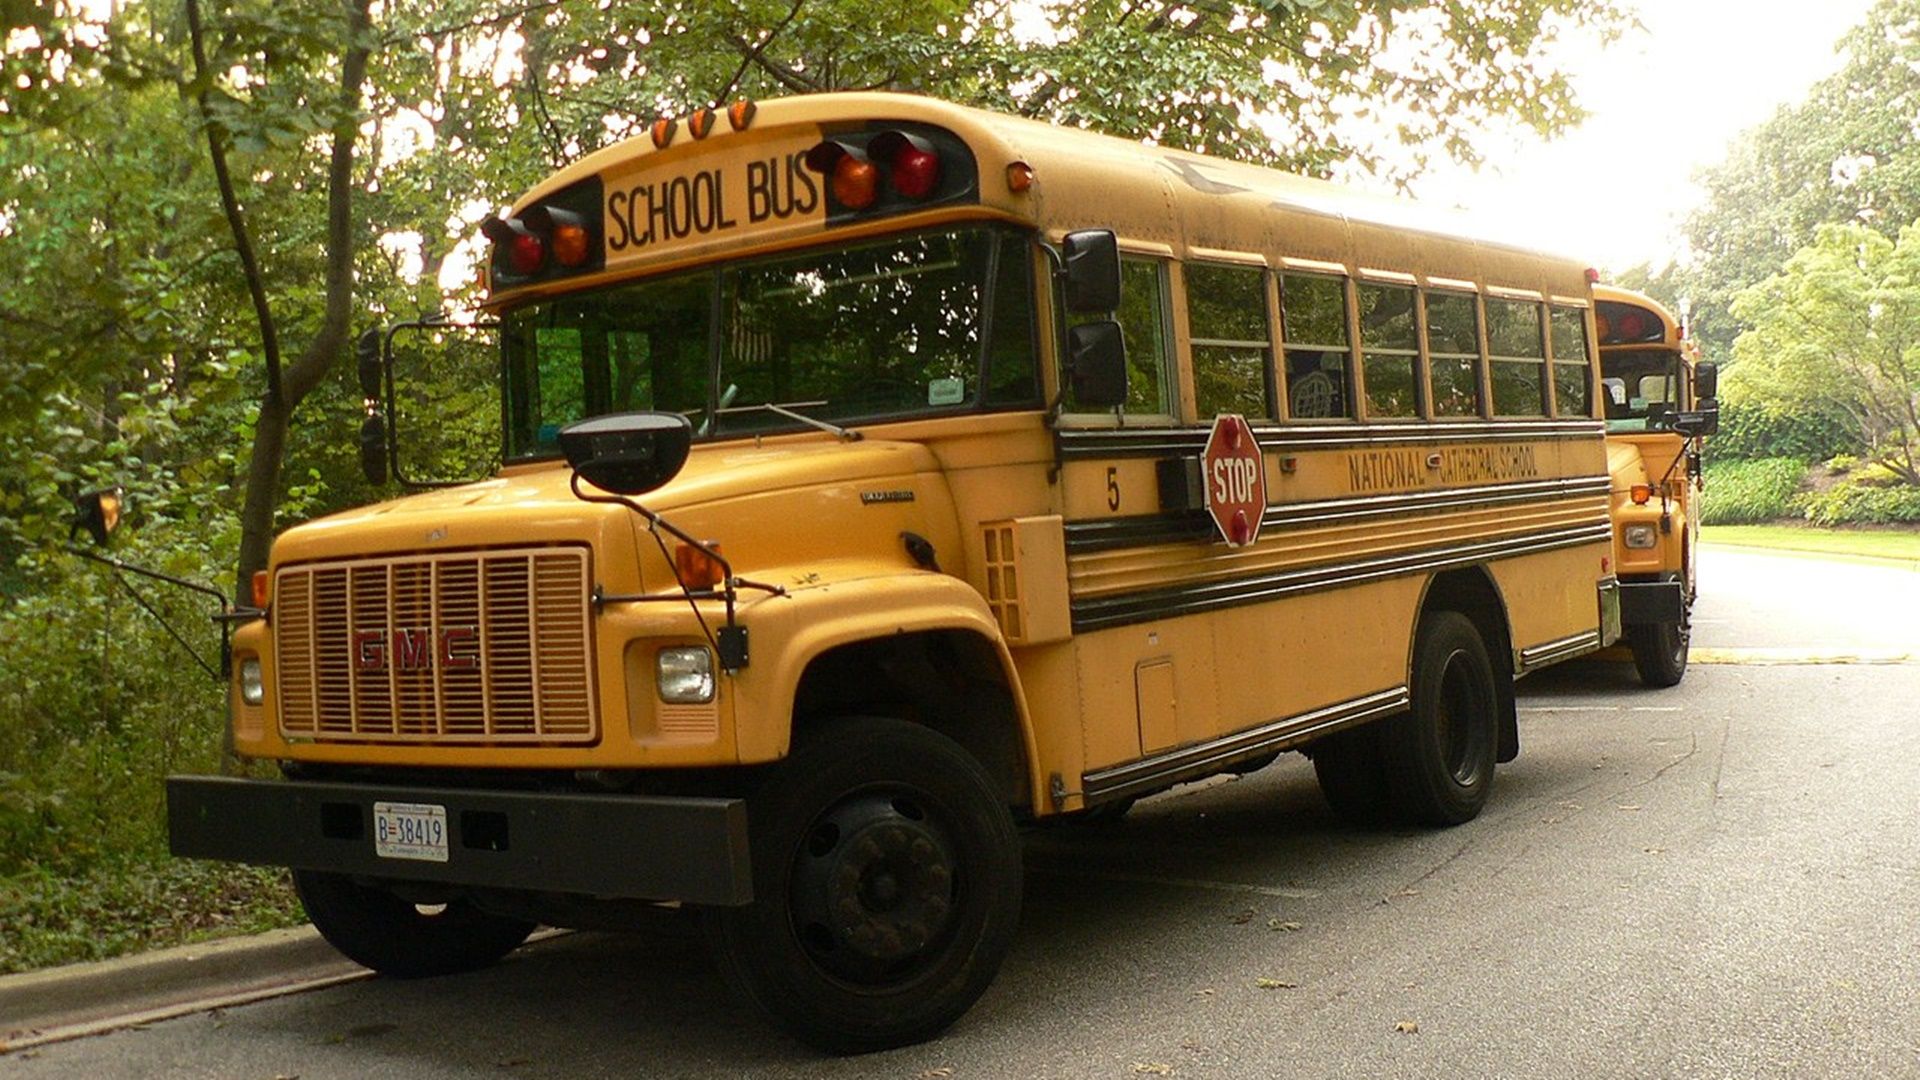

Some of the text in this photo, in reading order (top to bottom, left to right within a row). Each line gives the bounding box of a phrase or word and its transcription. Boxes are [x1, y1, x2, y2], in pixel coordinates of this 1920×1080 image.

[608, 151, 818, 251] SCHOOL BUS
[1107, 467, 1120, 512] 5
[1214, 457, 1257, 504] STOP
[1349, 445, 1537, 491] NATIONAL CATHEDRAL SCHOOL
[354, 625, 476, 671] GMC
